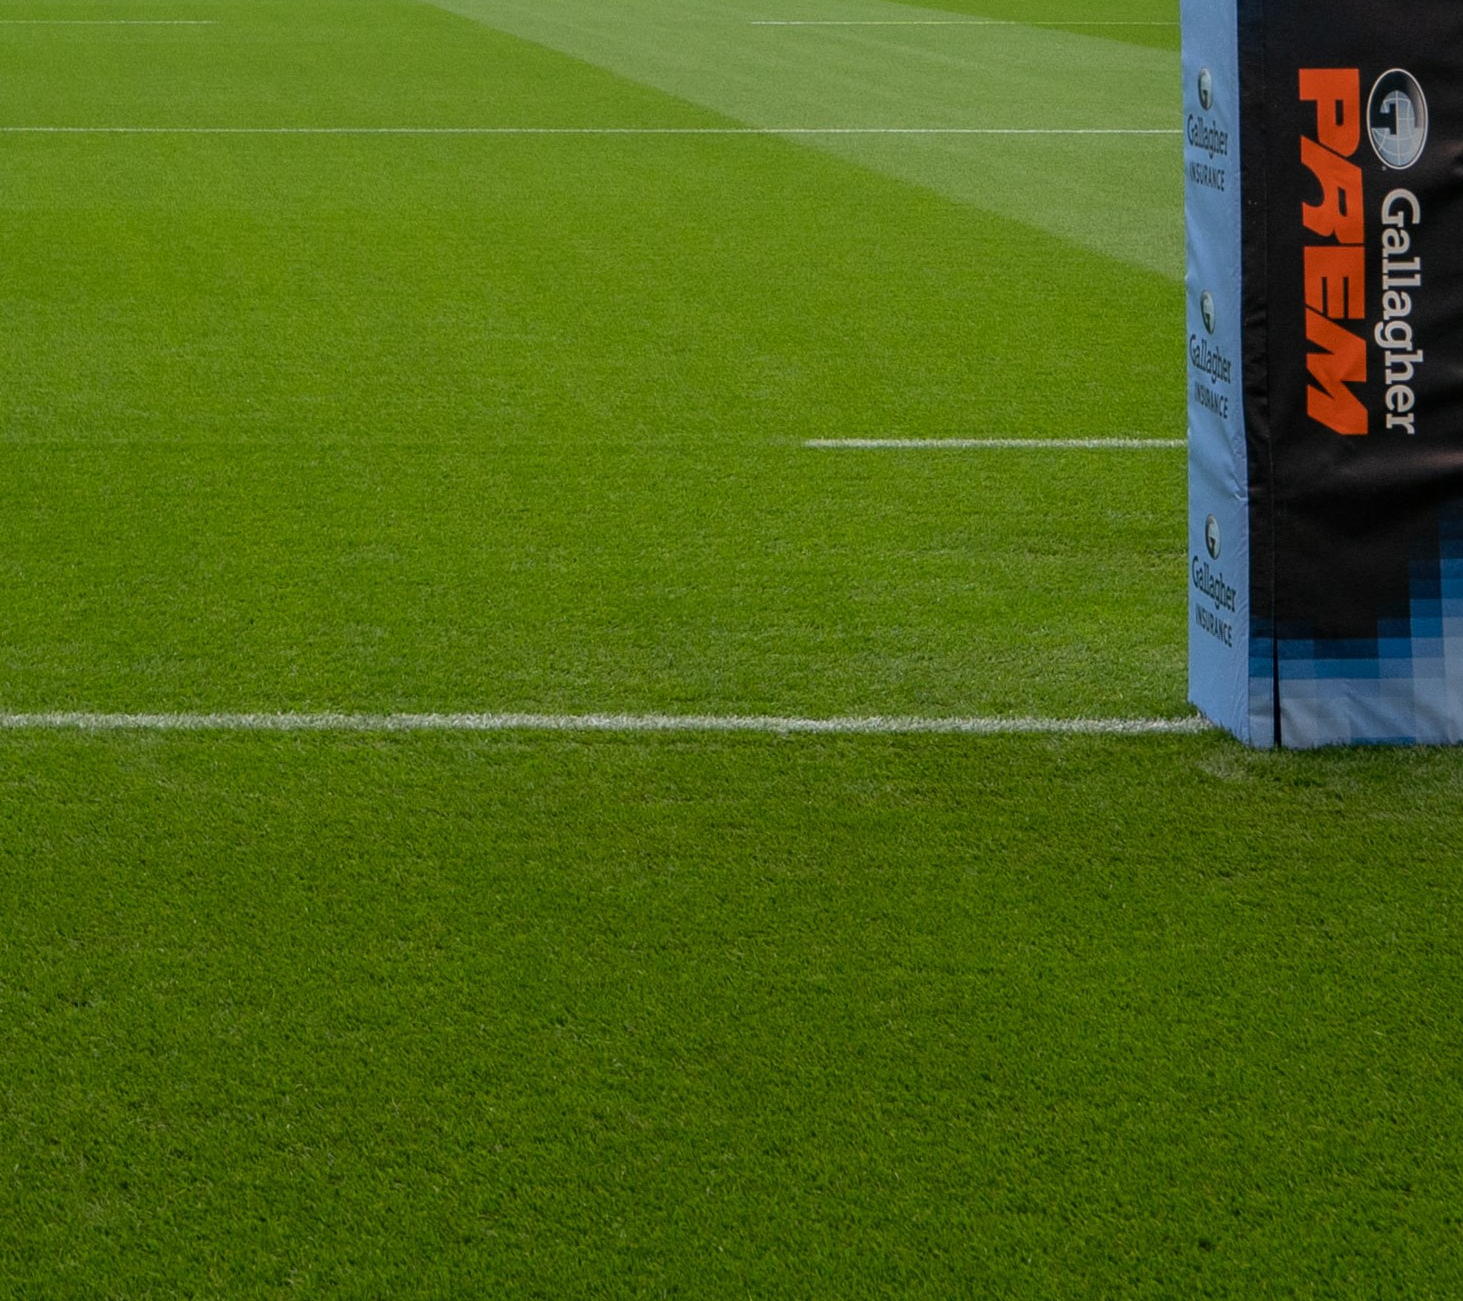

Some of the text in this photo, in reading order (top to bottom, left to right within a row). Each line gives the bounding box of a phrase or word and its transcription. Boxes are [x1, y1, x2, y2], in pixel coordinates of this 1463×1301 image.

[1187, 114, 1229, 158] Gallagher
[1190, 160, 1225, 192] INSURANCE
[1298, 68, 1368, 435] PREM
[1375, 188, 1423, 434] Gallagher
[1189, 333, 1231, 384] Gallagher
[1194, 382, 1229, 420] INSURANCE
[1192, 555, 1236, 612] Gallagher
[1195, 607, 1233, 648] INSURANCE
